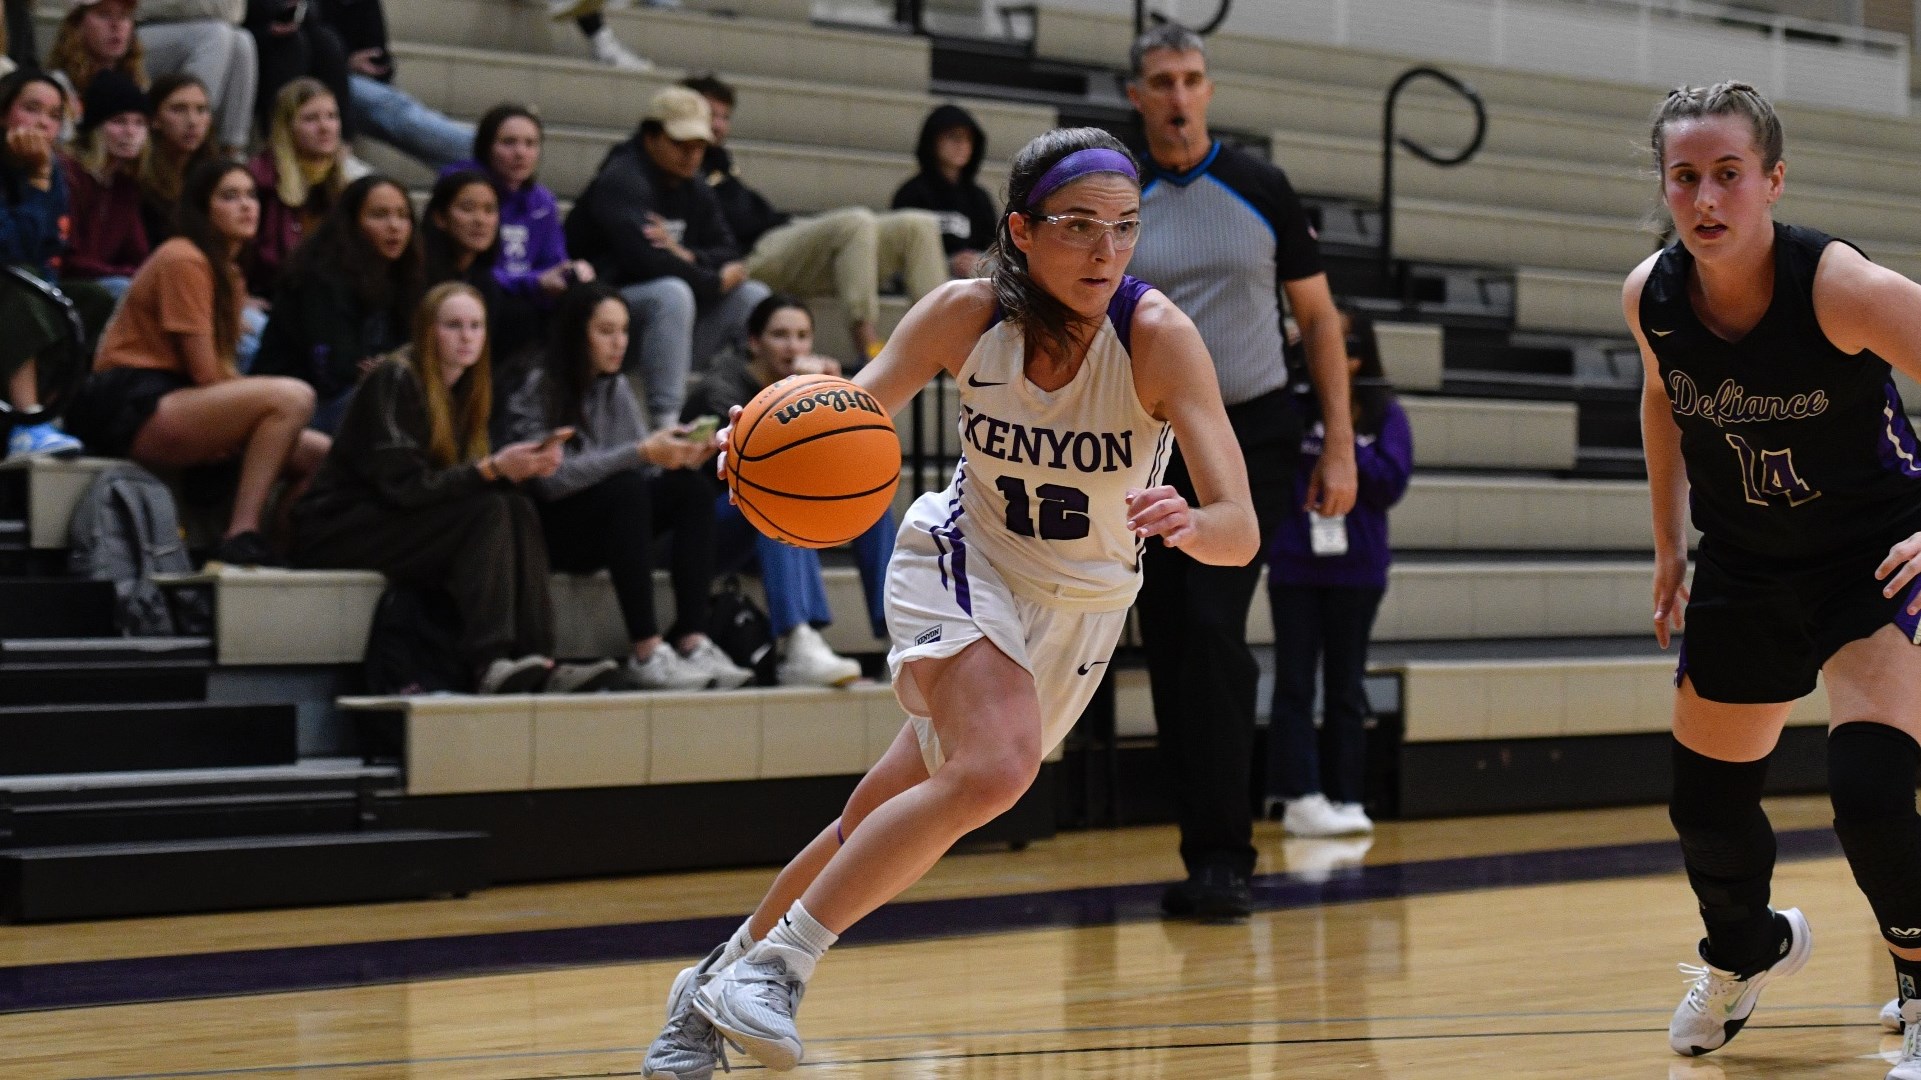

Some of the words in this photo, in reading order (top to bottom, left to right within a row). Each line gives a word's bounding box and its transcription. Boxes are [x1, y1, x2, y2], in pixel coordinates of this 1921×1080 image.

[774, 390, 884, 424] Wilson
[1669, 370, 1829, 427] Defiance
[964, 404, 1132, 473] KENYON
[1726, 433, 1821, 507] 14
[995, 475, 1090, 541] 12
[917, 628, 940, 645] KENYON
